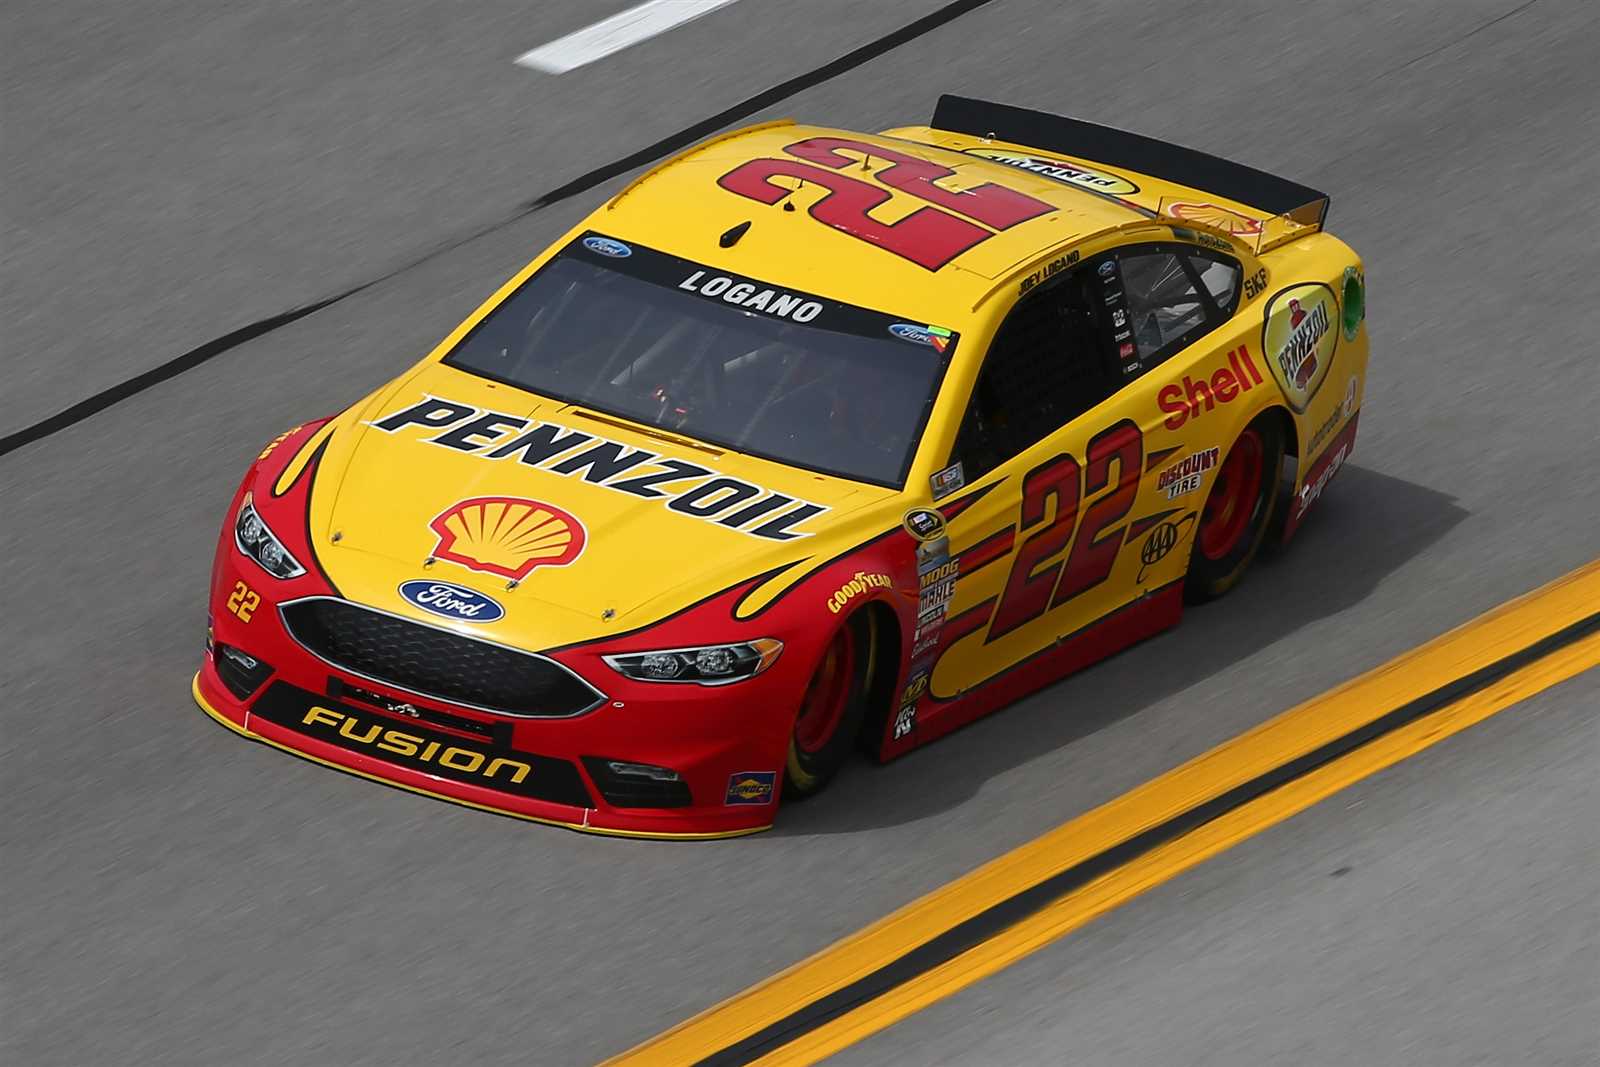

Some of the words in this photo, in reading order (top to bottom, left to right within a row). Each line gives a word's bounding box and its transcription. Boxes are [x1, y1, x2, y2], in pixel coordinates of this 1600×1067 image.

[717, 137, 1059, 272] 22
[679, 271, 823, 323] LOGANO
[1018, 271, 1041, 296] JOEY
[1043, 250, 1081, 278] LOGANO
[1244, 268, 1268, 300] SKF
[1278, 300, 1329, 388] PENNZOIL
[1158, 345, 1263, 430] Shell
[368, 394, 830, 541] PENNZOIL
[1158, 449, 1219, 490] DISCOUNT
[1170, 476, 1199, 497] TIRE
[984, 418, 1142, 645] 22
[920, 558, 960, 587] MOOG
[226, 580, 261, 623] 22
[416, 585, 487, 617] Ford
[302, 706, 532, 783] FUSION
